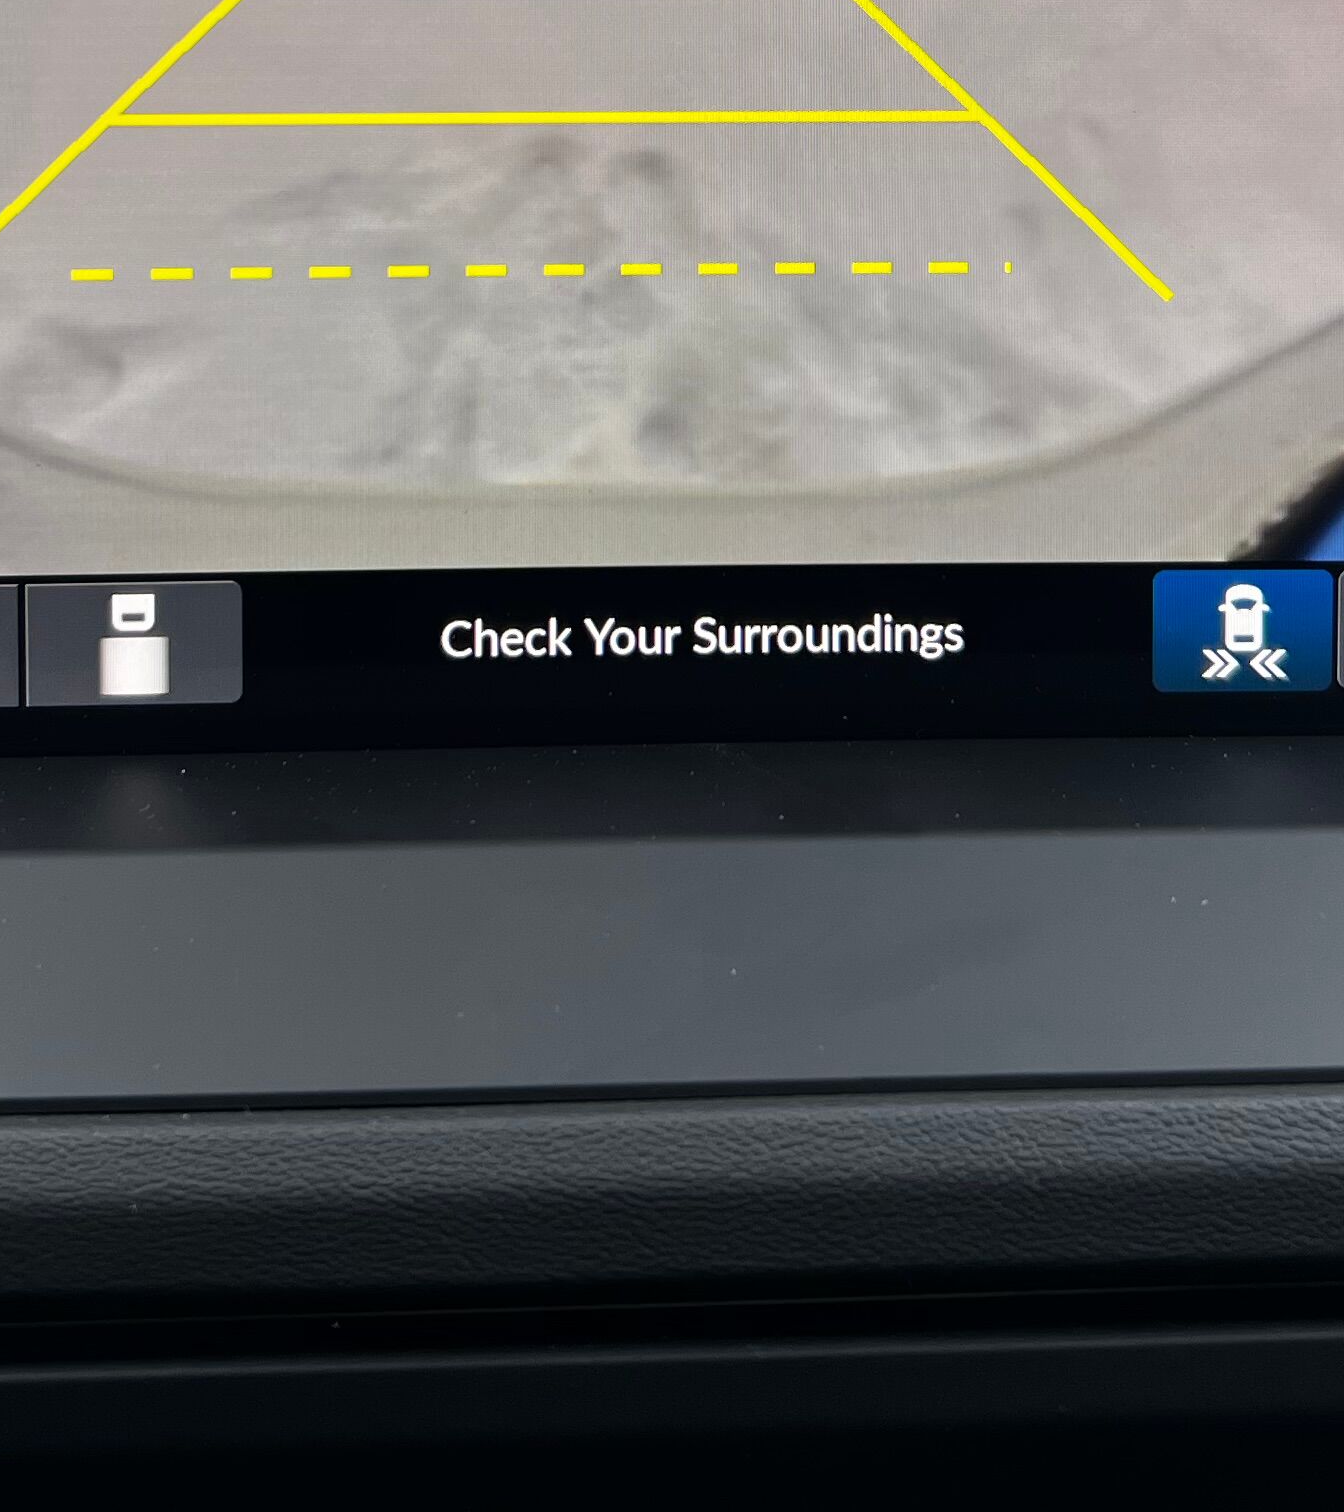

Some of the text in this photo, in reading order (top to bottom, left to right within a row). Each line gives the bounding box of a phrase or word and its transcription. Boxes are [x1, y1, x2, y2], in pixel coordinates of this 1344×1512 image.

[440, 612, 965, 659] Check Your Surroundings
